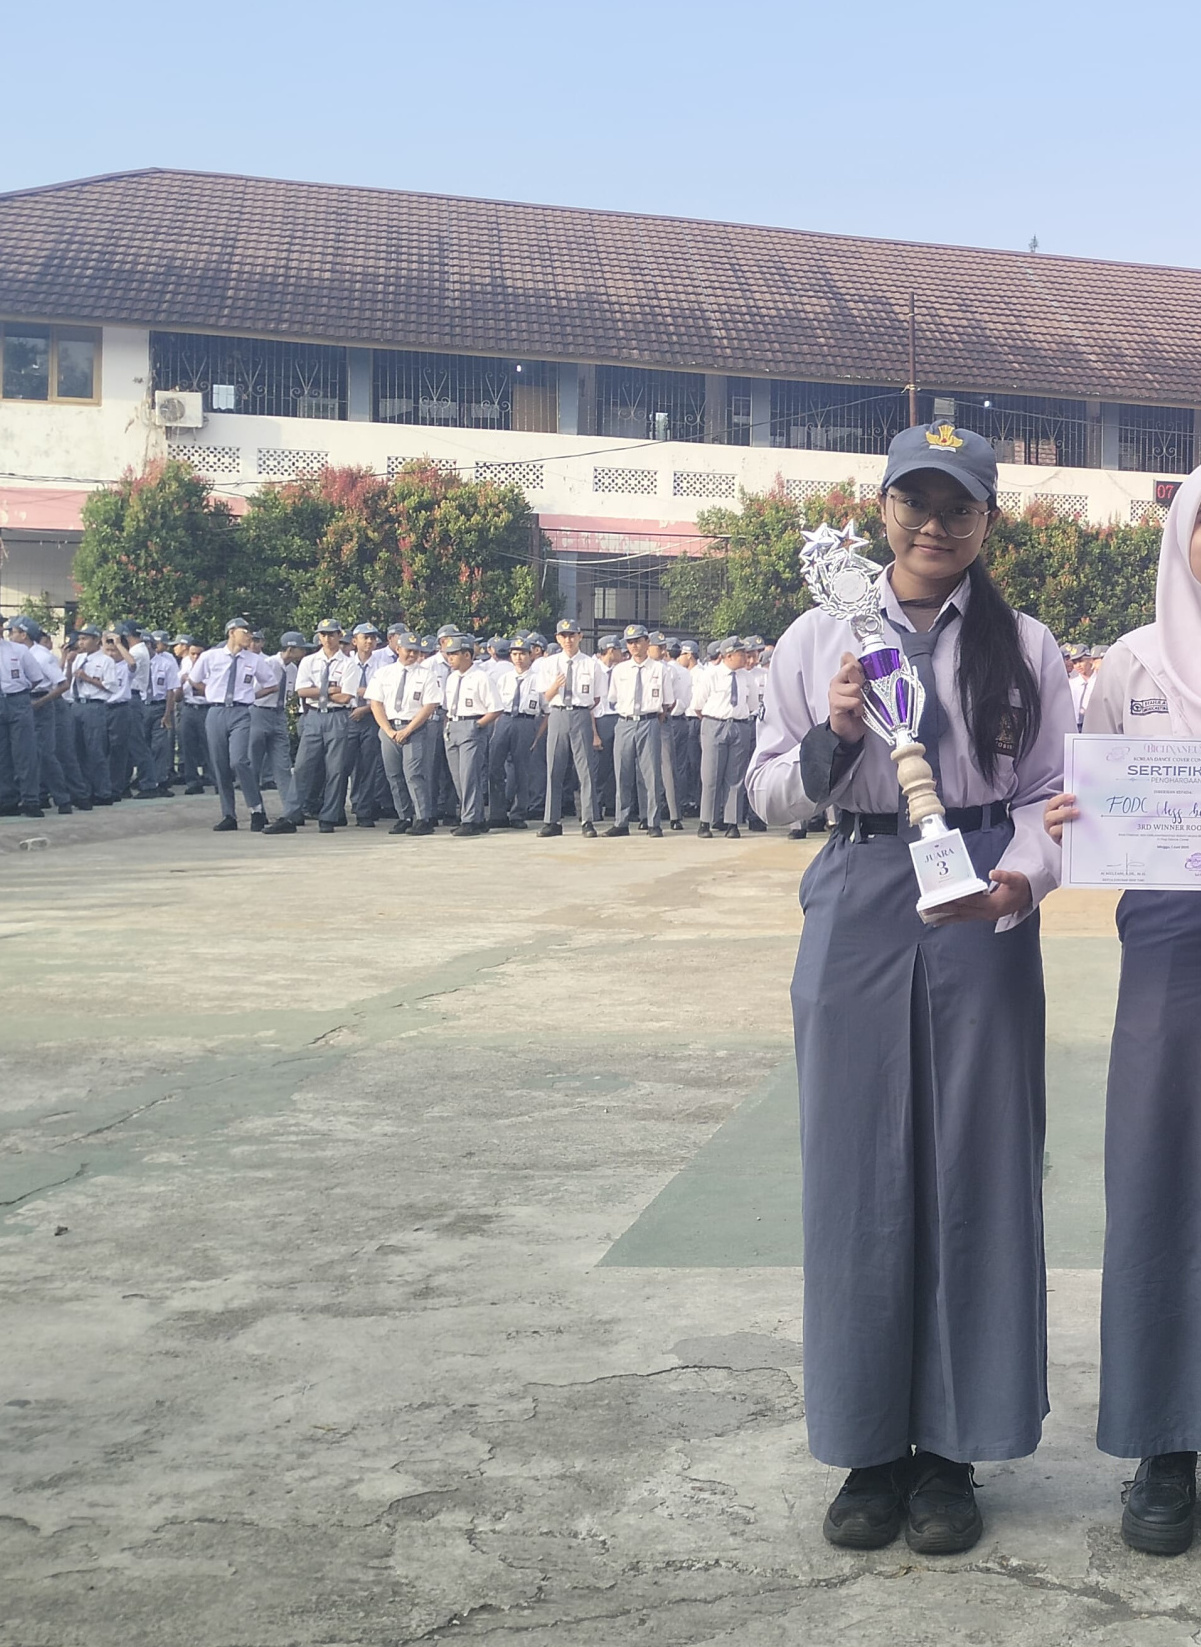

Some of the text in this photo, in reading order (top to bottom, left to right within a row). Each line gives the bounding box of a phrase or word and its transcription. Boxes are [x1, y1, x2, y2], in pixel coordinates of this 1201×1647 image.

[1157, 484, 1174, 499] 07
[1136, 823, 1152, 831] 3RD
[1153, 823, 1185, 832] WINNER
[924, 847, 955, 863] JUARA
[936, 860, 949, 876] 3
